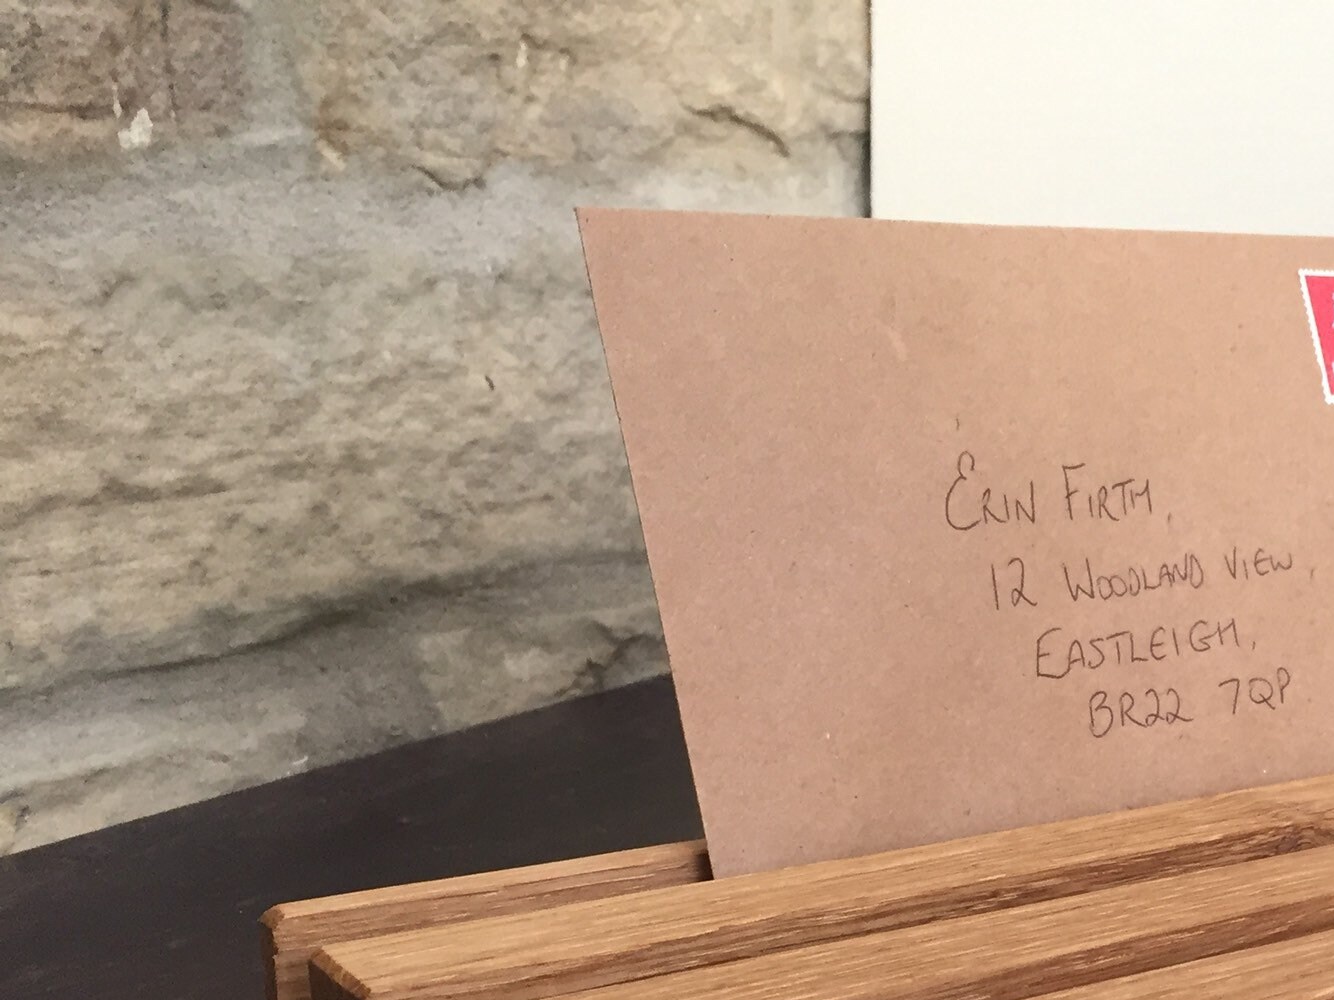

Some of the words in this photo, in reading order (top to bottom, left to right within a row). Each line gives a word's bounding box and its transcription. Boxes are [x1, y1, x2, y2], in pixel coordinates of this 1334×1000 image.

[990, 557, 1038, 610] 12
[1062, 552, 1205, 602] WOODLAND
[1036, 618, 1257, 679] EASTLEIGH,
[1089, 689, 1193, 739] BR22
[1218, 666, 1291, 716] 7QP
